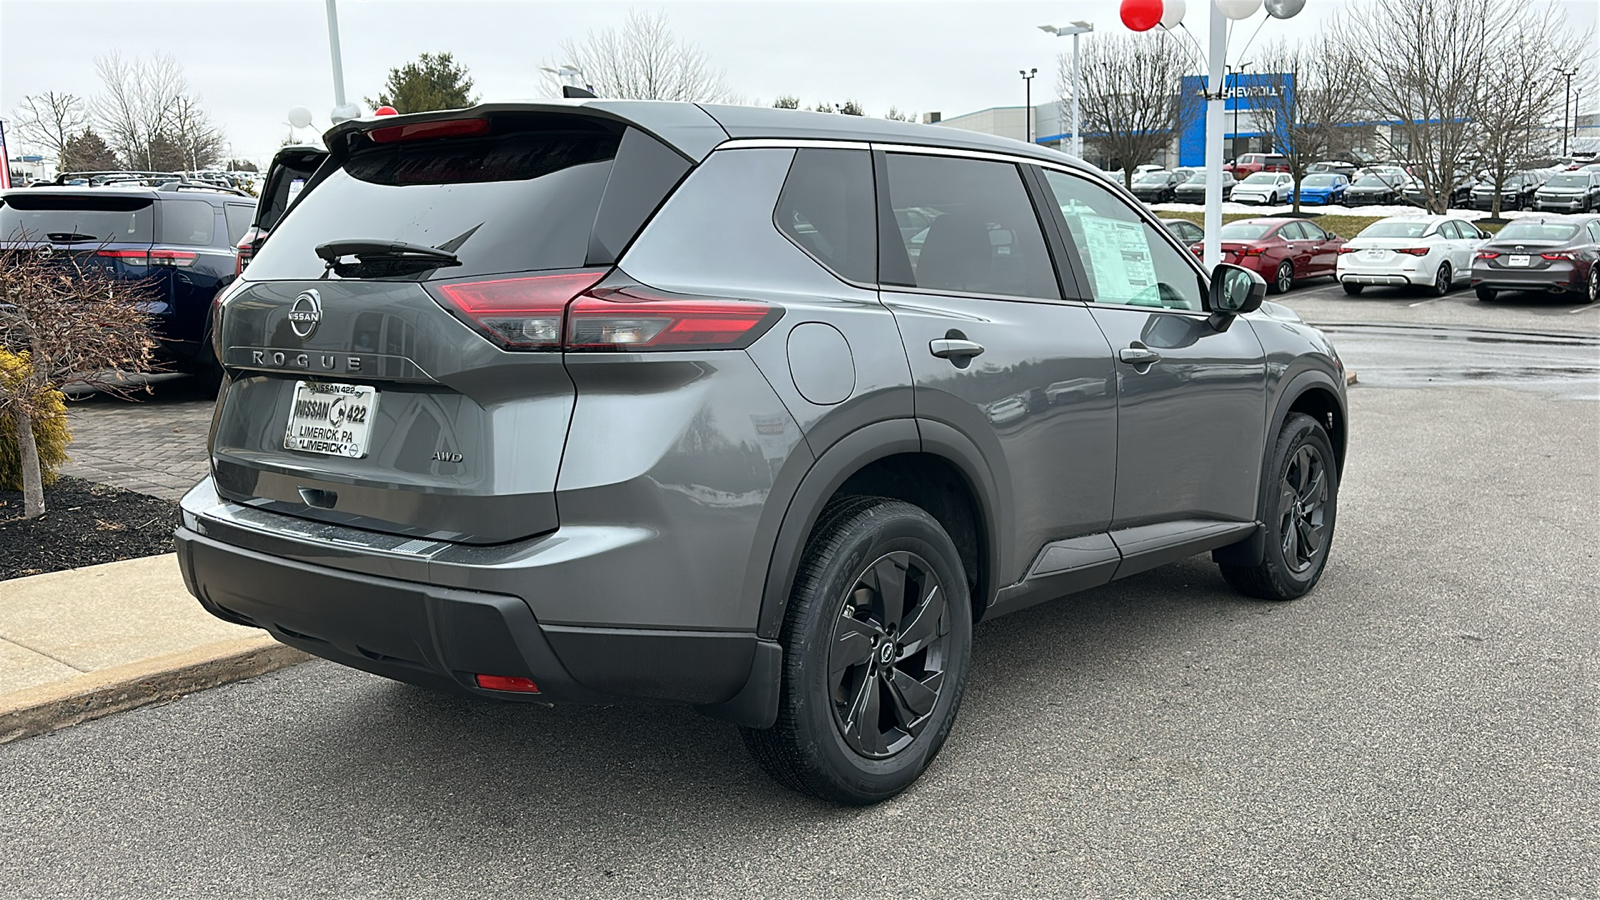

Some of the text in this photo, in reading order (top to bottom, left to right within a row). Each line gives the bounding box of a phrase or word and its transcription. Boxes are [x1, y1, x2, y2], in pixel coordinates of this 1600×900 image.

[253, 350, 361, 371] ROGUE
[312, 383, 355, 394] NISSAN 422
[297, 400, 366, 423] NISSAN 422
[341, 430, 353, 443] PA
[431, 451, 463, 463] AWD
